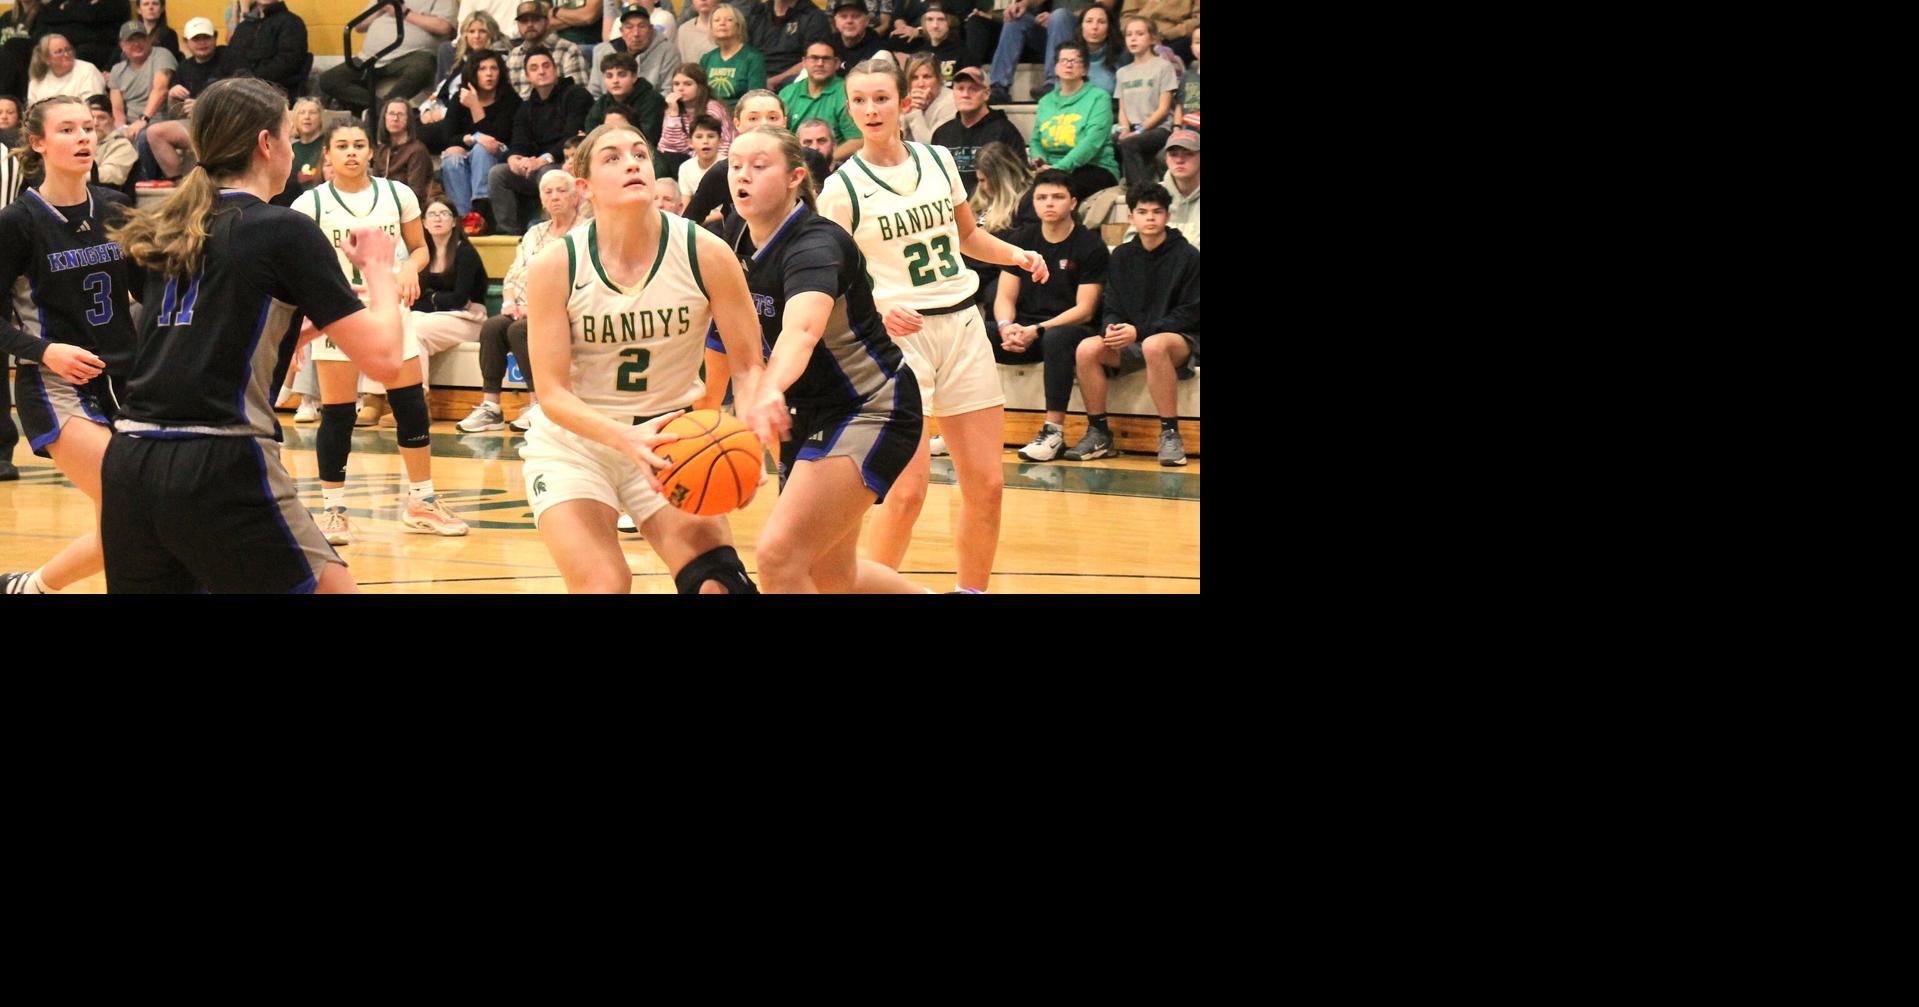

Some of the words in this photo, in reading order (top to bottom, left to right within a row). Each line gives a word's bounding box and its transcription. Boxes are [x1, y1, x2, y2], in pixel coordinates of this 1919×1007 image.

[878, 198, 954, 241] BANDYS
[903, 234, 959, 287] 23
[83, 271, 114, 326] 3
[583, 306, 690, 343] BANDYS
[616, 348, 650, 392] 2
